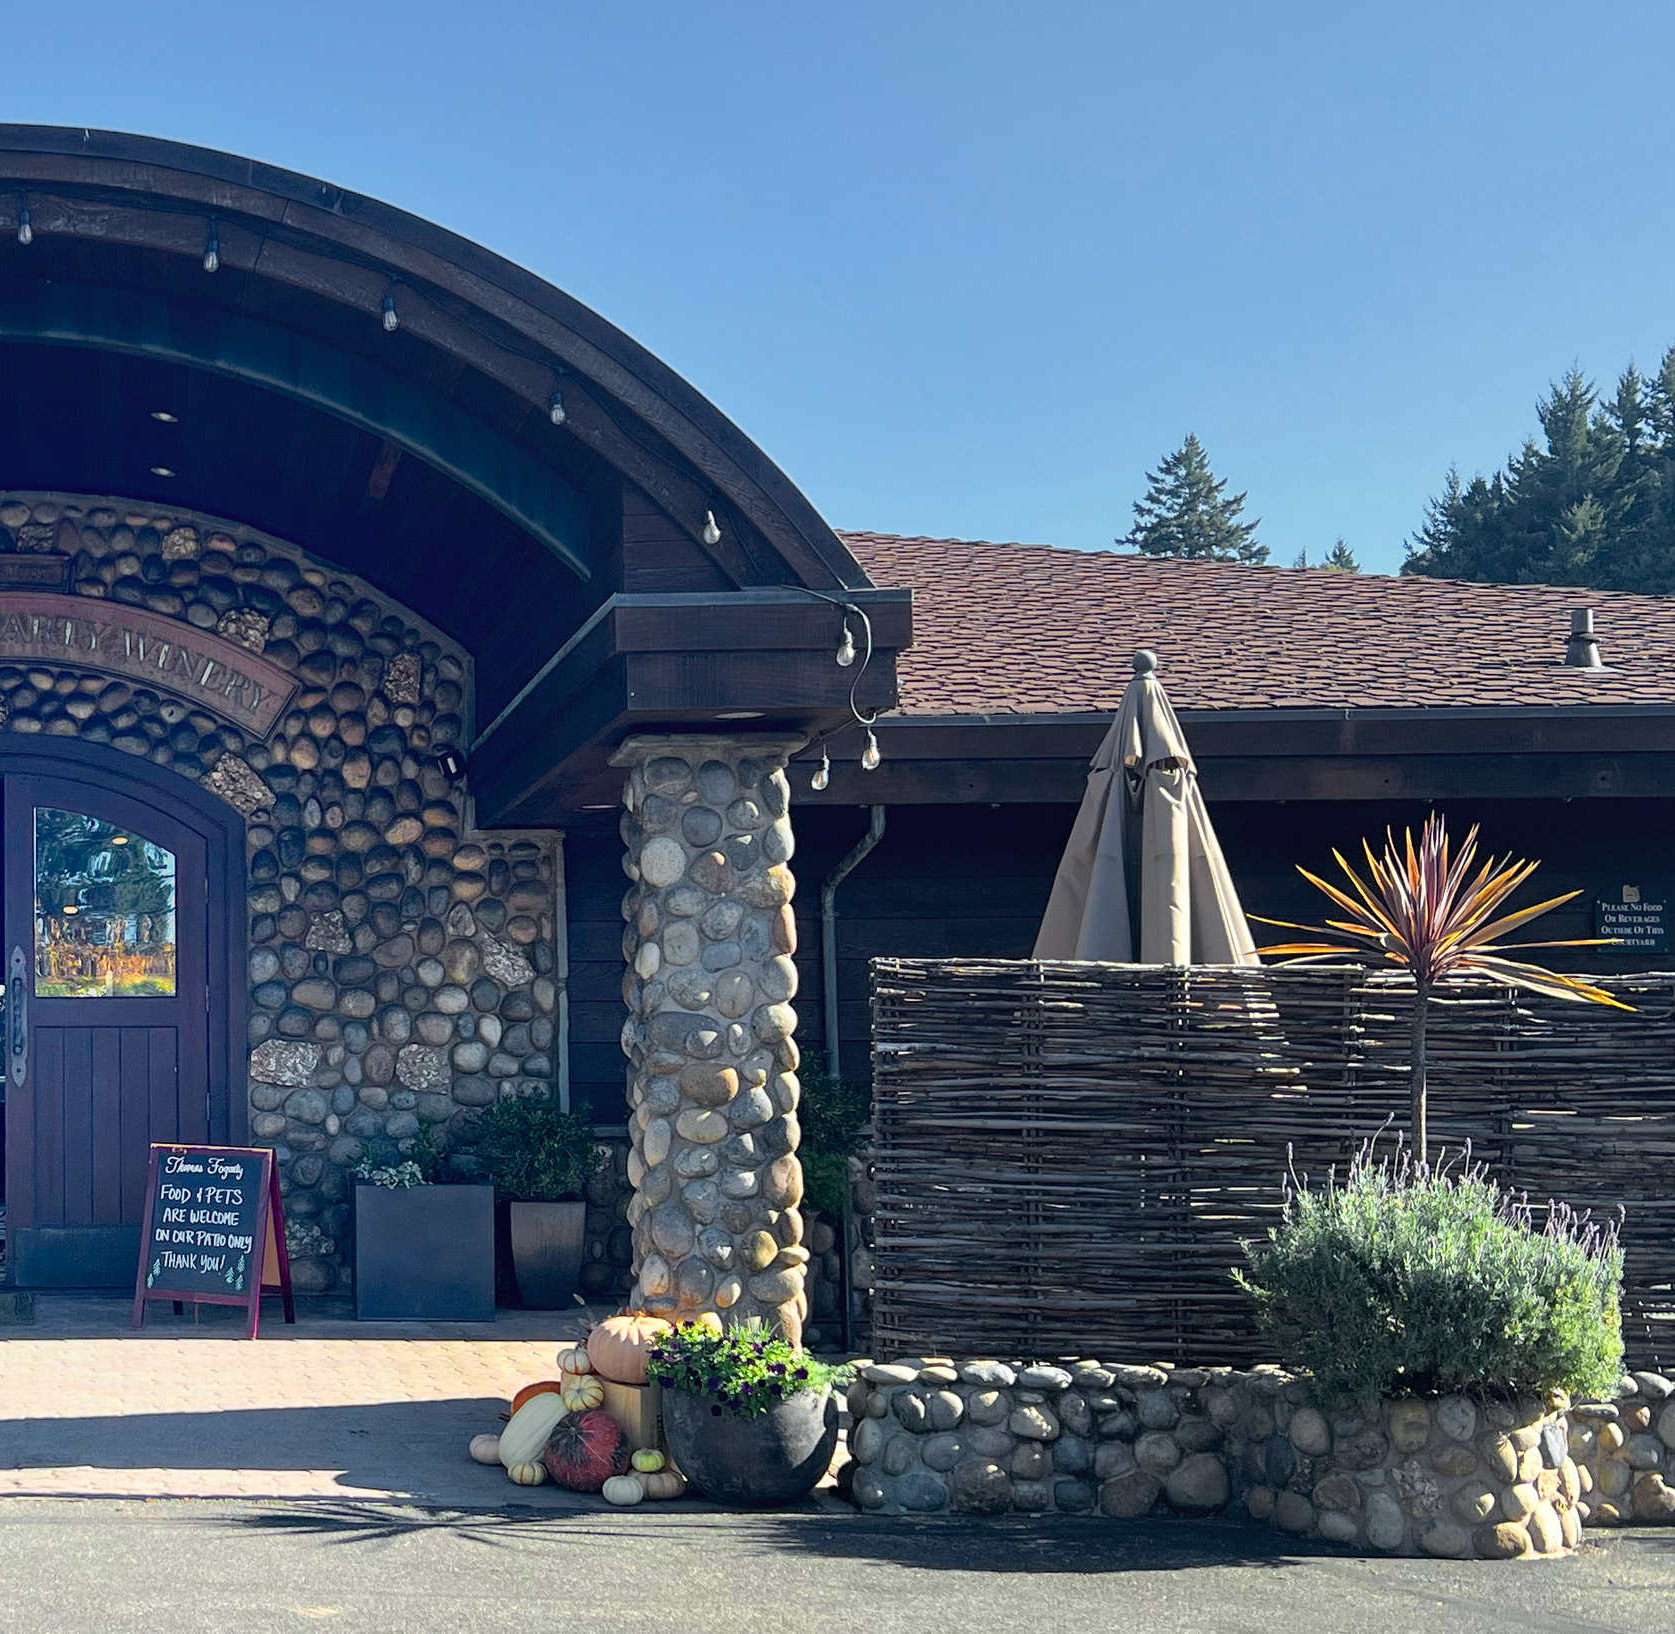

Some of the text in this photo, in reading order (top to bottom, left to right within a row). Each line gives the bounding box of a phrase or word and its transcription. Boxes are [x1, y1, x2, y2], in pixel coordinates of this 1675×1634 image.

[121, 627, 278, 715] WINERY
[1601, 902, 1630, 912] PLEASE
[1643, 902, 1663, 912] FOOD
[1618, 914, 1661, 923] BEVERAGES
[165, 1156, 244, 1181] Thomas Fogarty
[160, 1183, 192, 1205] FOOD
[205, 1185, 244, 1206] PETS
[162, 1207, 240, 1226] ARE WELCOME
[155, 1228, 253, 1254] ON OUR PATIO ONLY
[160, 1250, 226, 1276] THANK YOU!
